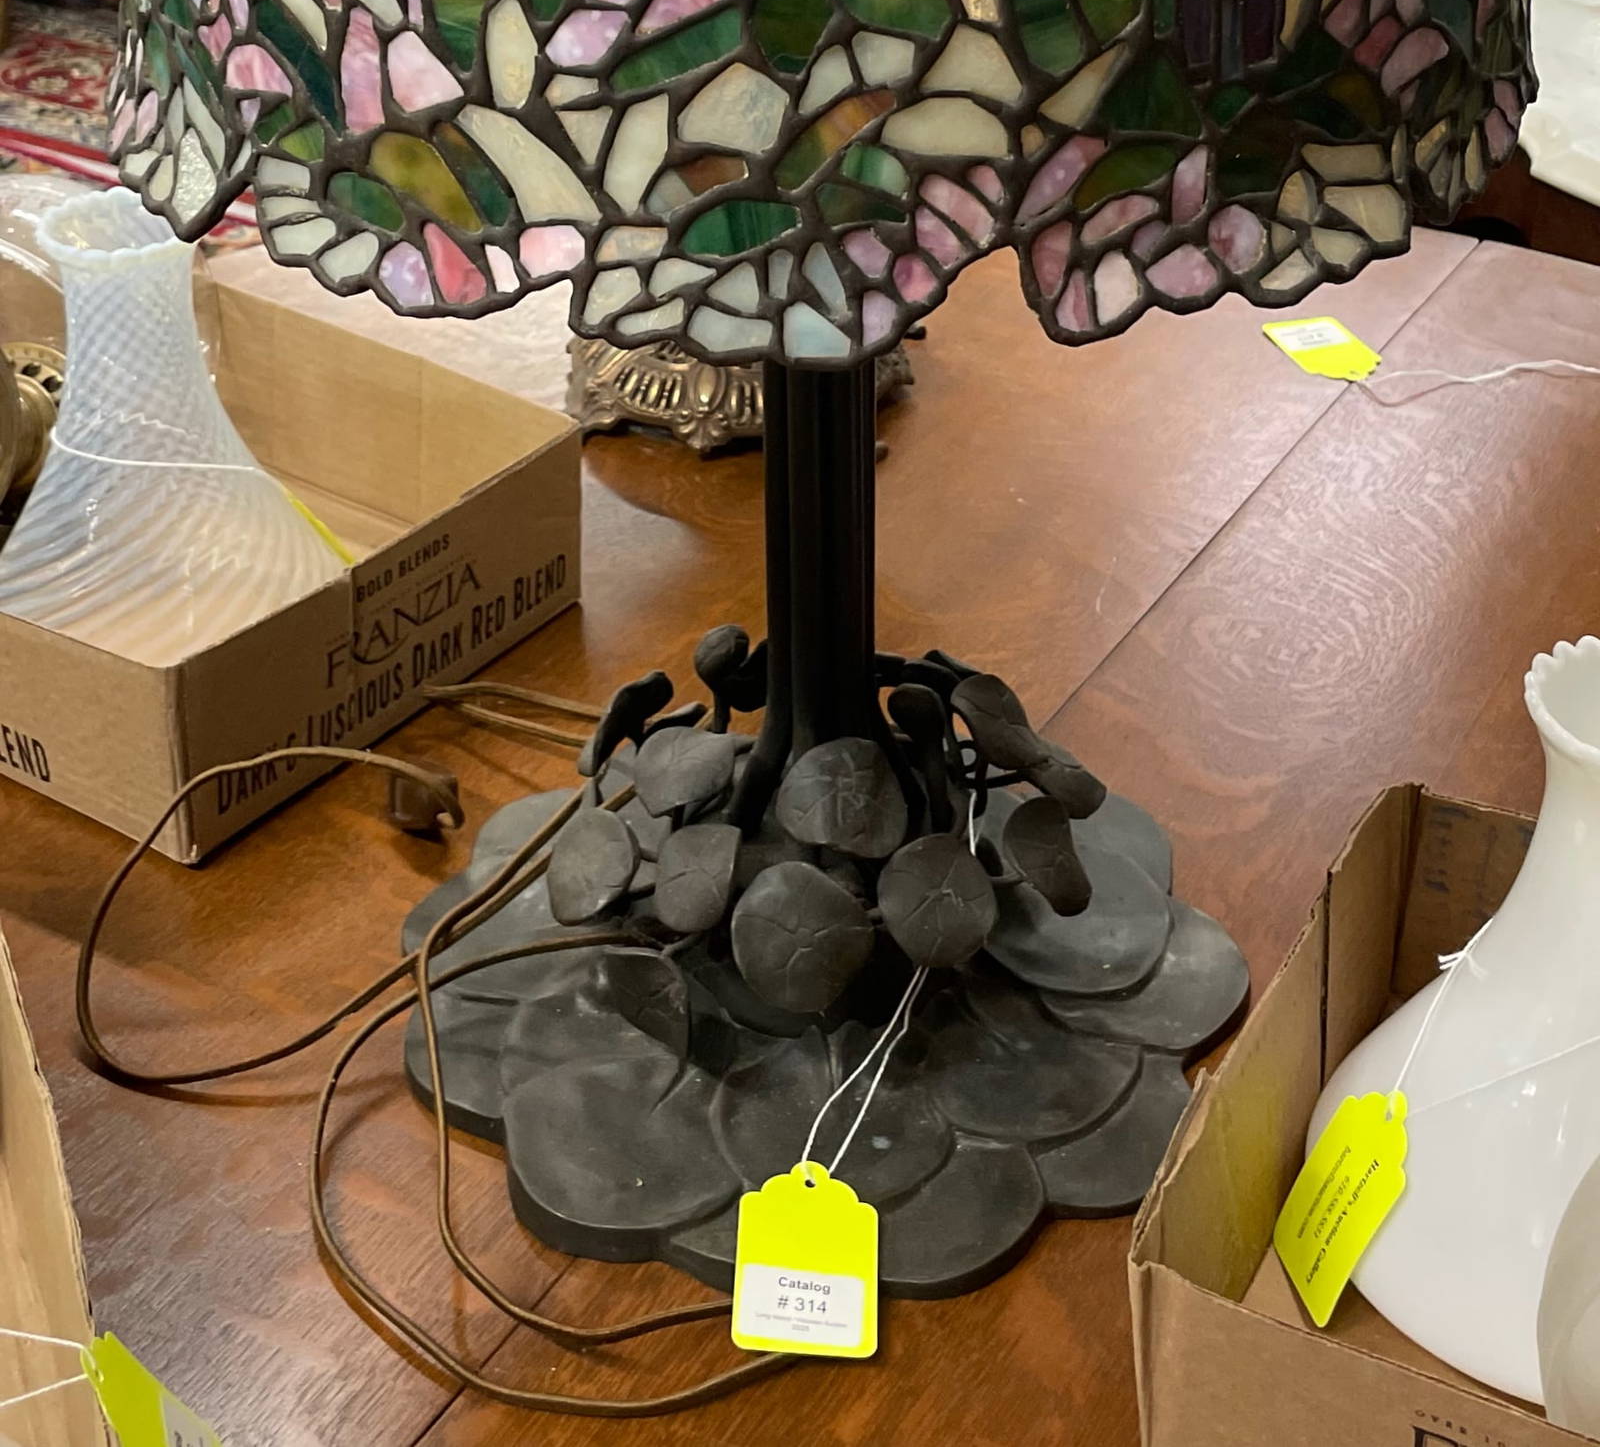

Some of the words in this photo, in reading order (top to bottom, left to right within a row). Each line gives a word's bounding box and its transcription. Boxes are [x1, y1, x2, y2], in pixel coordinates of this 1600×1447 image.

[356, 569, 393, 603] BOLD
[398, 533, 450, 578] BLENDS
[411, 622, 463, 688] DARK
[470, 595, 505, 650] RED
[513, 554, 566, 621] BLEND
[0, 723, 51, 782] END
[1325, 1207, 1348, 1246] Auction
[1306, 1247, 1327, 1284] Gallery
[777, 1295, 790, 1309] #
[794, 1297, 828, 1314] 314
[778, 1276, 831, 1295] Catalog
